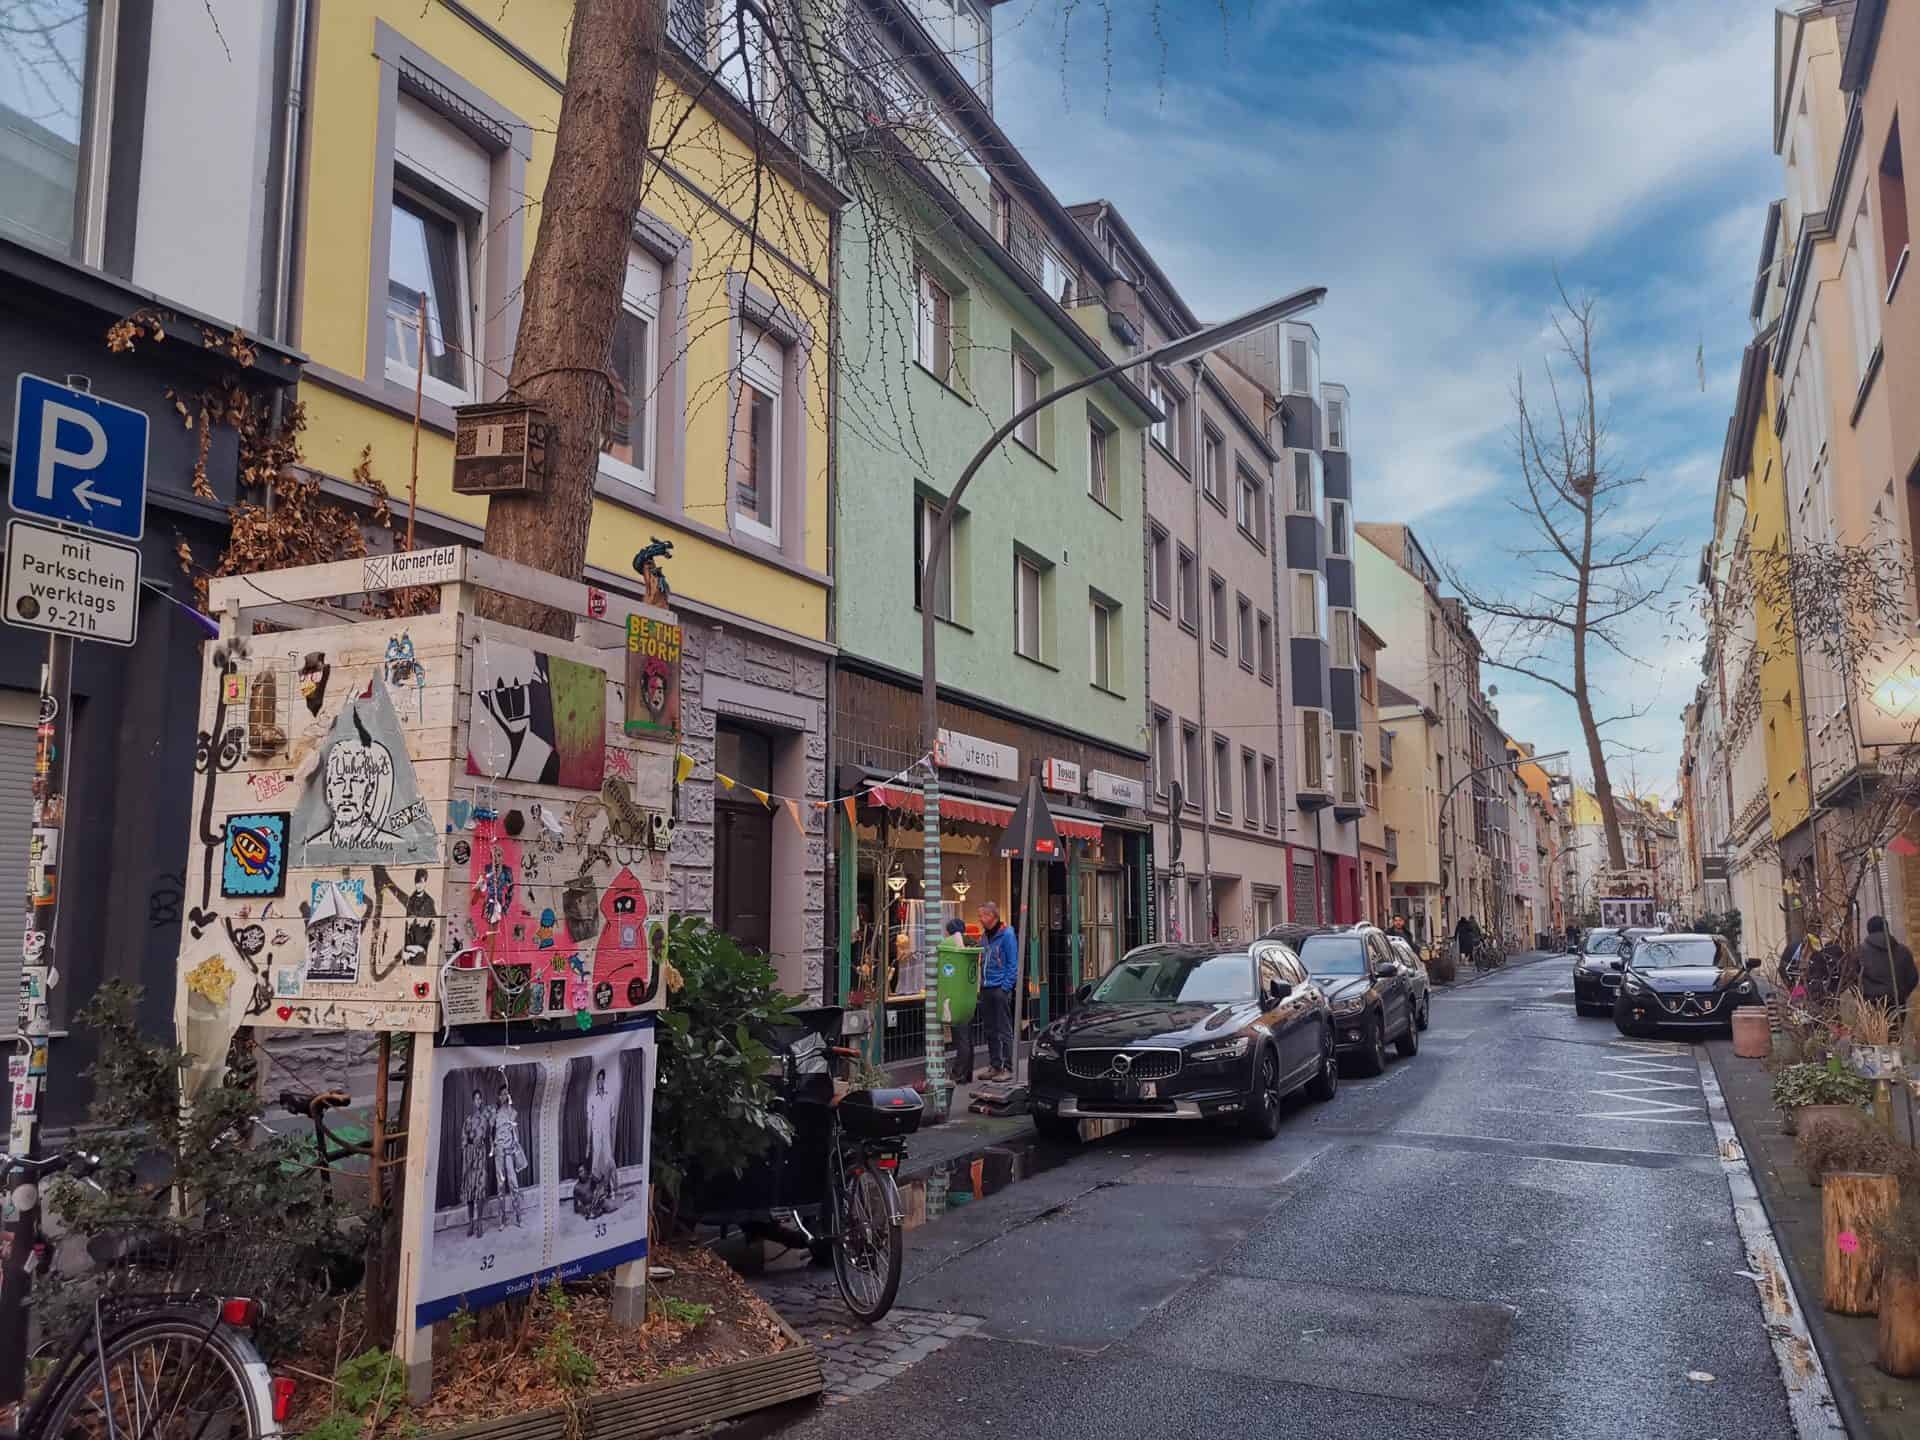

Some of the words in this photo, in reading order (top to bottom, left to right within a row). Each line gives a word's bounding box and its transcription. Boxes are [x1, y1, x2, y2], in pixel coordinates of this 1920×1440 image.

[37, 400, 107, 499] P
[62, 542, 91, 561] mit
[392, 548, 454, 571] Körnerfeld
[23, 554, 124, 592] Parkschein
[391, 569, 456, 586] GALERIE
[30, 581, 116, 613] werktags
[630, 615, 649, 637] BE
[655, 622, 680, 645] THE
[629, 637, 679, 662] STORM
[480, 1254, 495, 1271] 32
